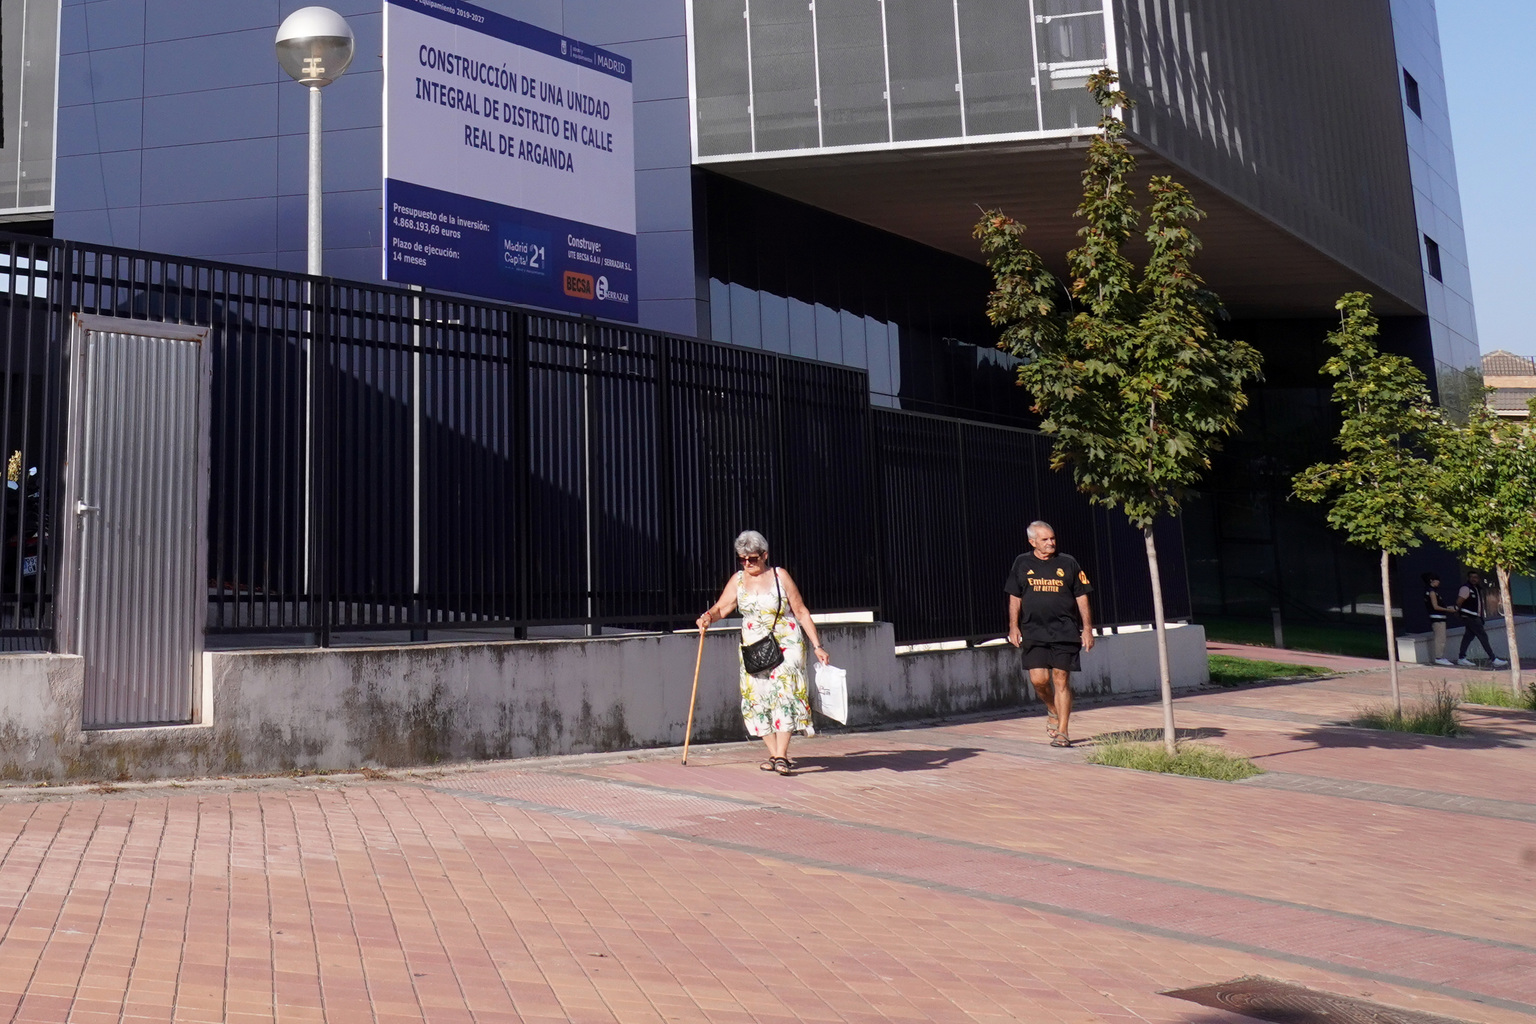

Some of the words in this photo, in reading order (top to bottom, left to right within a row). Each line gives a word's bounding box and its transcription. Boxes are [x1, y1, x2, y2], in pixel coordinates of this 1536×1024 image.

[597, 54, 626, 74] MADRID
[419, 44, 517, 94] CONSTRUCCIÓN
[521, 75, 536, 99] DE
[540, 81, 564, 108] UNA
[567, 89, 610, 121] UNIDAD
[415, 77, 480, 116] INTEGRAL
[484, 96, 499, 121] DE
[503, 102, 560, 137] DISTRITO
[563, 119, 578, 143] EN
[581, 125, 613, 153] CALLE
[465, 124, 496, 153] REAL
[499, 133, 514, 158] DE
[518, 139, 574, 173] ARGANDA
[393, 202, 437, 219] Presupuesto
[438, 212, 447, 223] de
[448, 214, 456, 225] la
[457, 216, 490, 232] inversión:
[393, 216, 440, 235] 4.868.193,69
[441, 227, 461, 239] euros
[392, 237, 413, 250] Plazo
[413, 241, 423, 252] de
[424, 244, 460, 259] ejecución:
[504, 238, 528, 254] Madrid
[567, 234, 602, 253] Construye:
[393, 251, 402, 262] 14
[403, 255, 427, 266] meses
[504, 251, 528, 266] Capital
[566, 276, 591, 294] BECSA
[1027, 577, 1064, 586] Emirates
